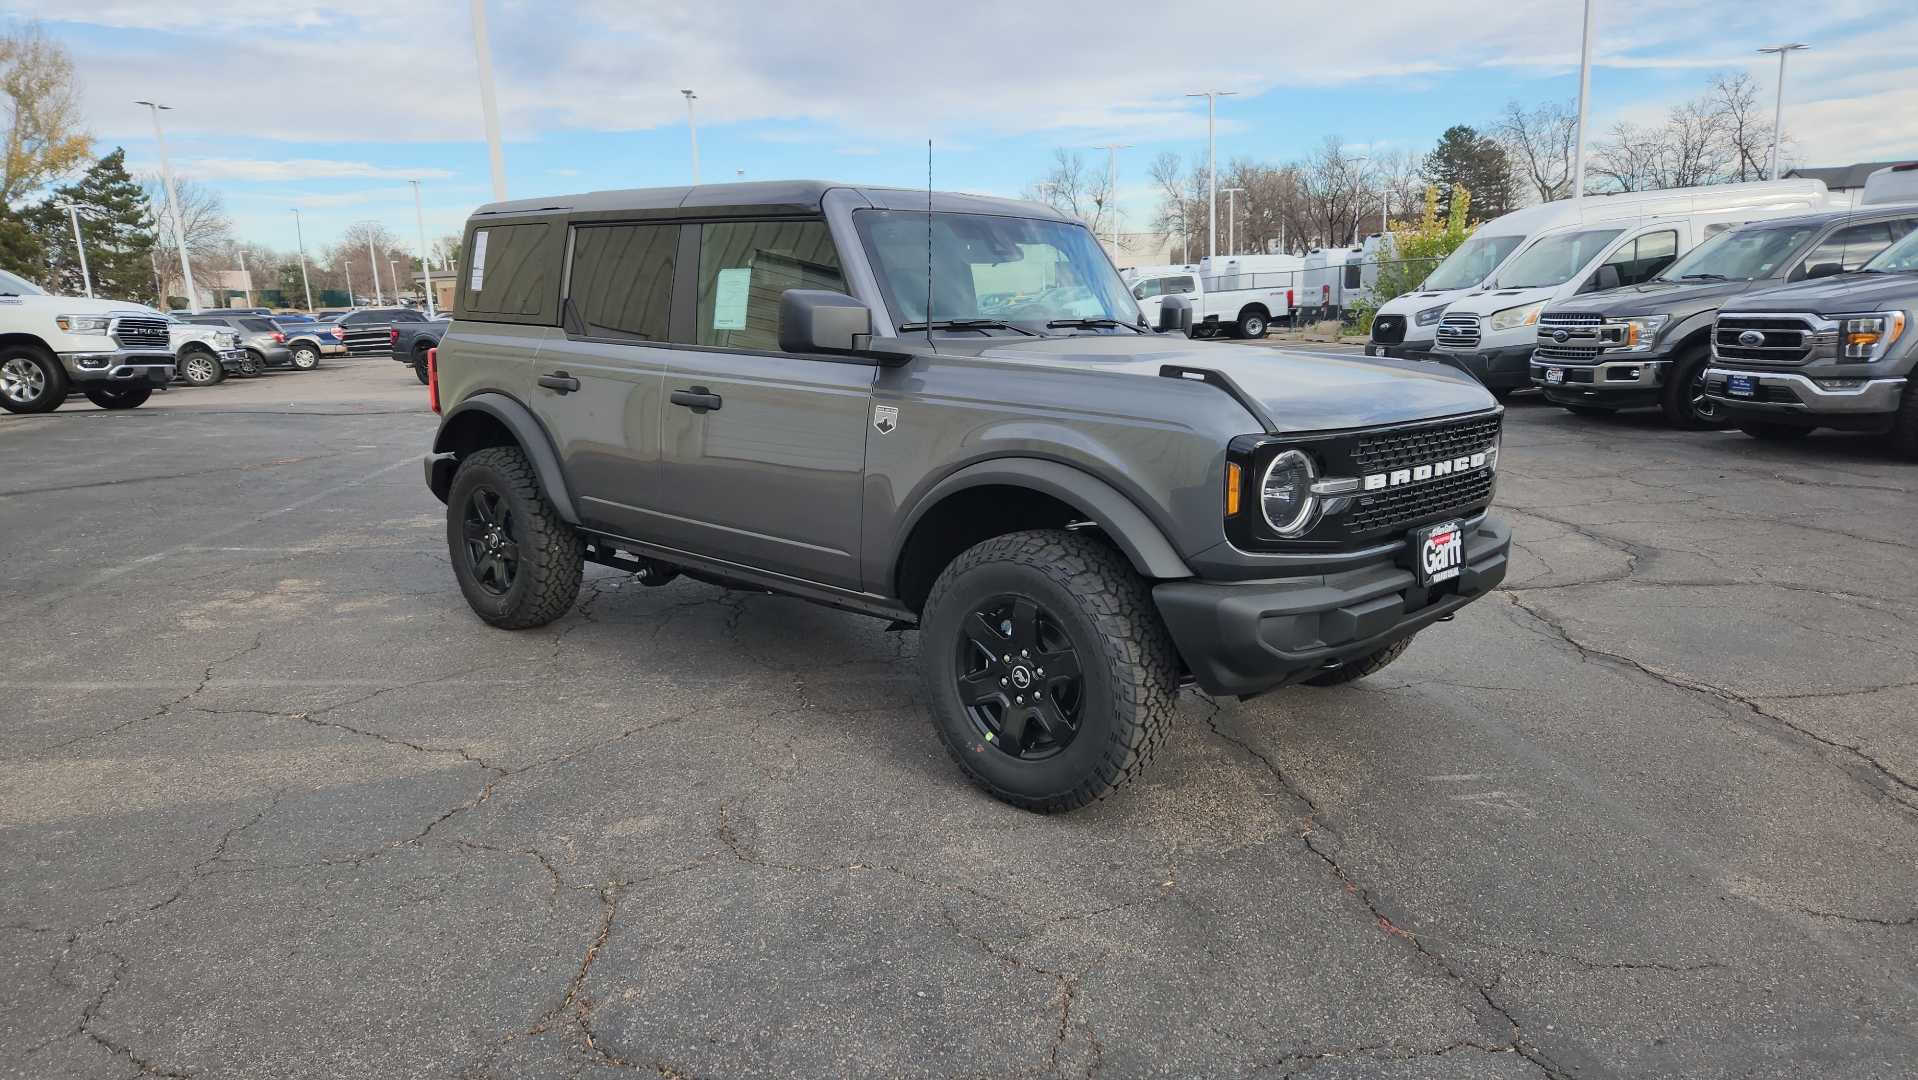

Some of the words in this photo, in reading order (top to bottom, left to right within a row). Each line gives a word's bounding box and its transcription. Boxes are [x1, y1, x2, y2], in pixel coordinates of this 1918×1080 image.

[1546, 369, 1563, 382] Garff
[1364, 452, 1485, 490] BRONCO
[1422, 530, 1462, 575] Garff
